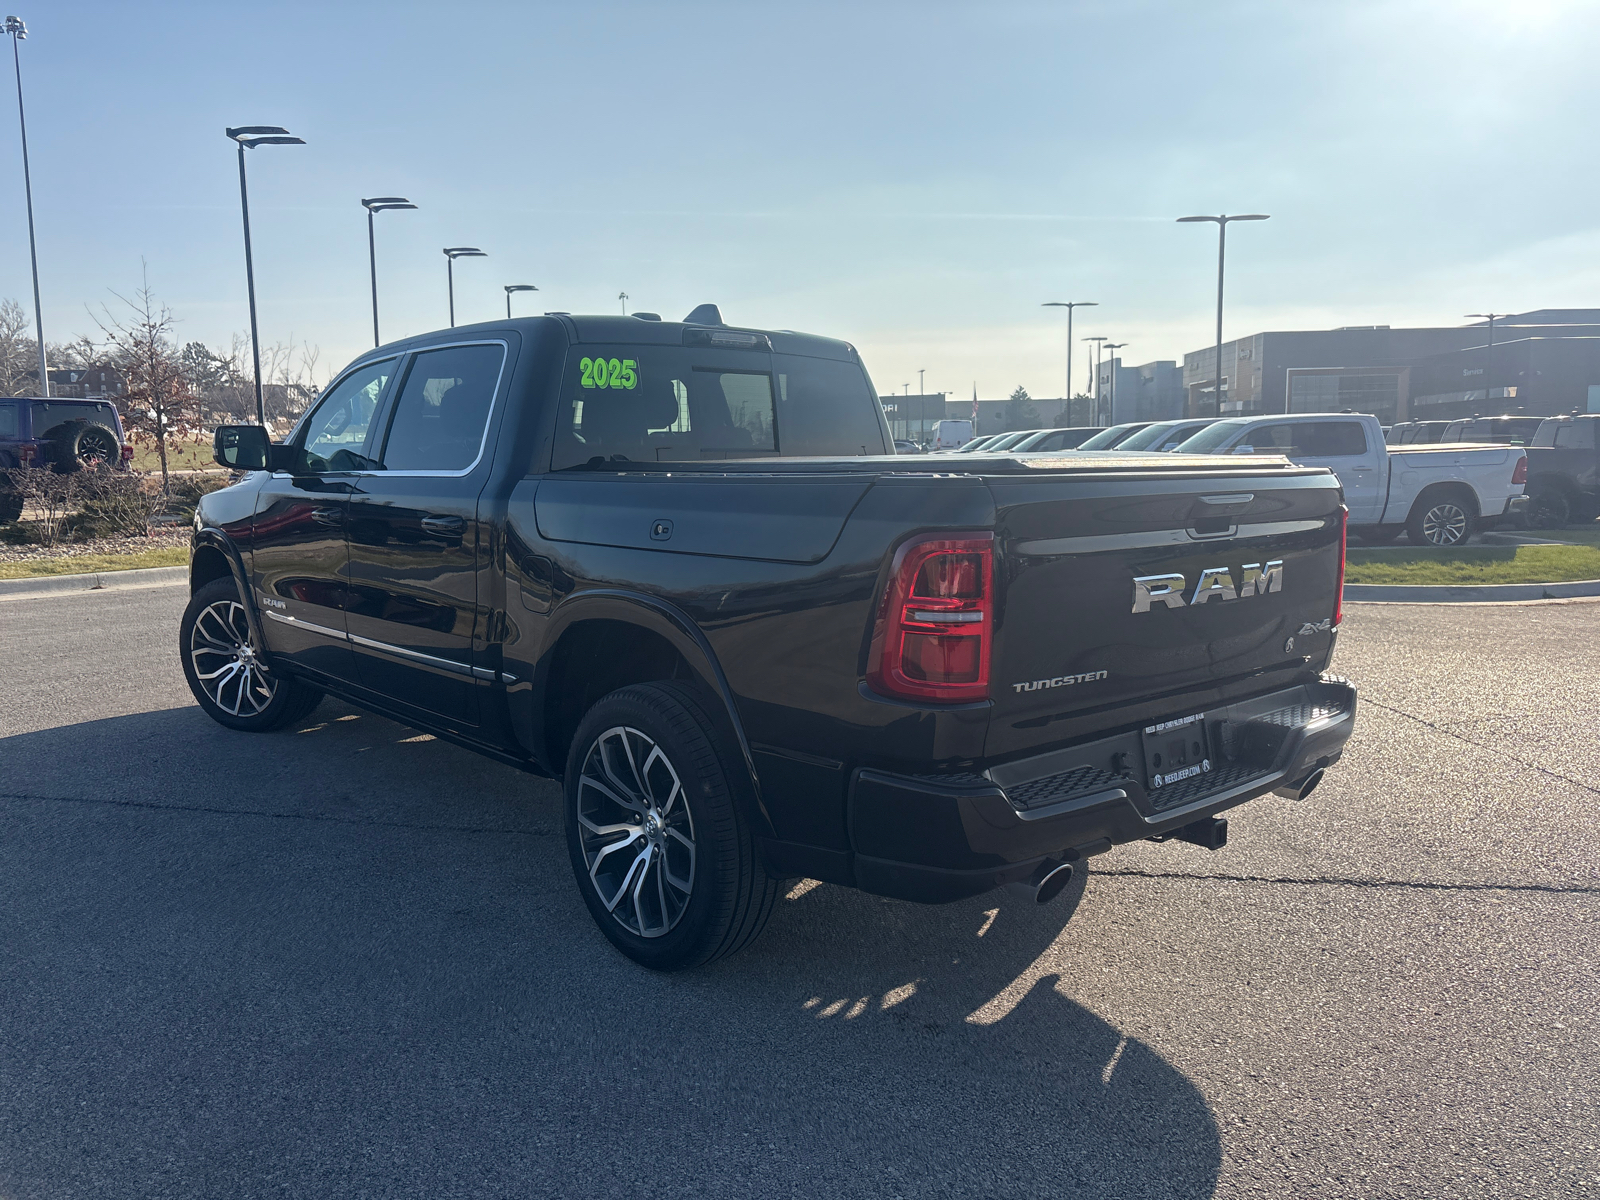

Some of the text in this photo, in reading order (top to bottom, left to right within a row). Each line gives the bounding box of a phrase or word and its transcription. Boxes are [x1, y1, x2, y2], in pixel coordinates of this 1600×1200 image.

[580, 357, 637, 390] 2025
[1131, 559, 1283, 614] RAM
[263, 597, 287, 610] RAM
[1012, 669, 1108, 693] TUNGSTEN
[1156, 723, 1164, 732] JEEP
[1164, 718, 1183, 729] CHRYSLER
[1183, 715, 1195, 724] DODGE
